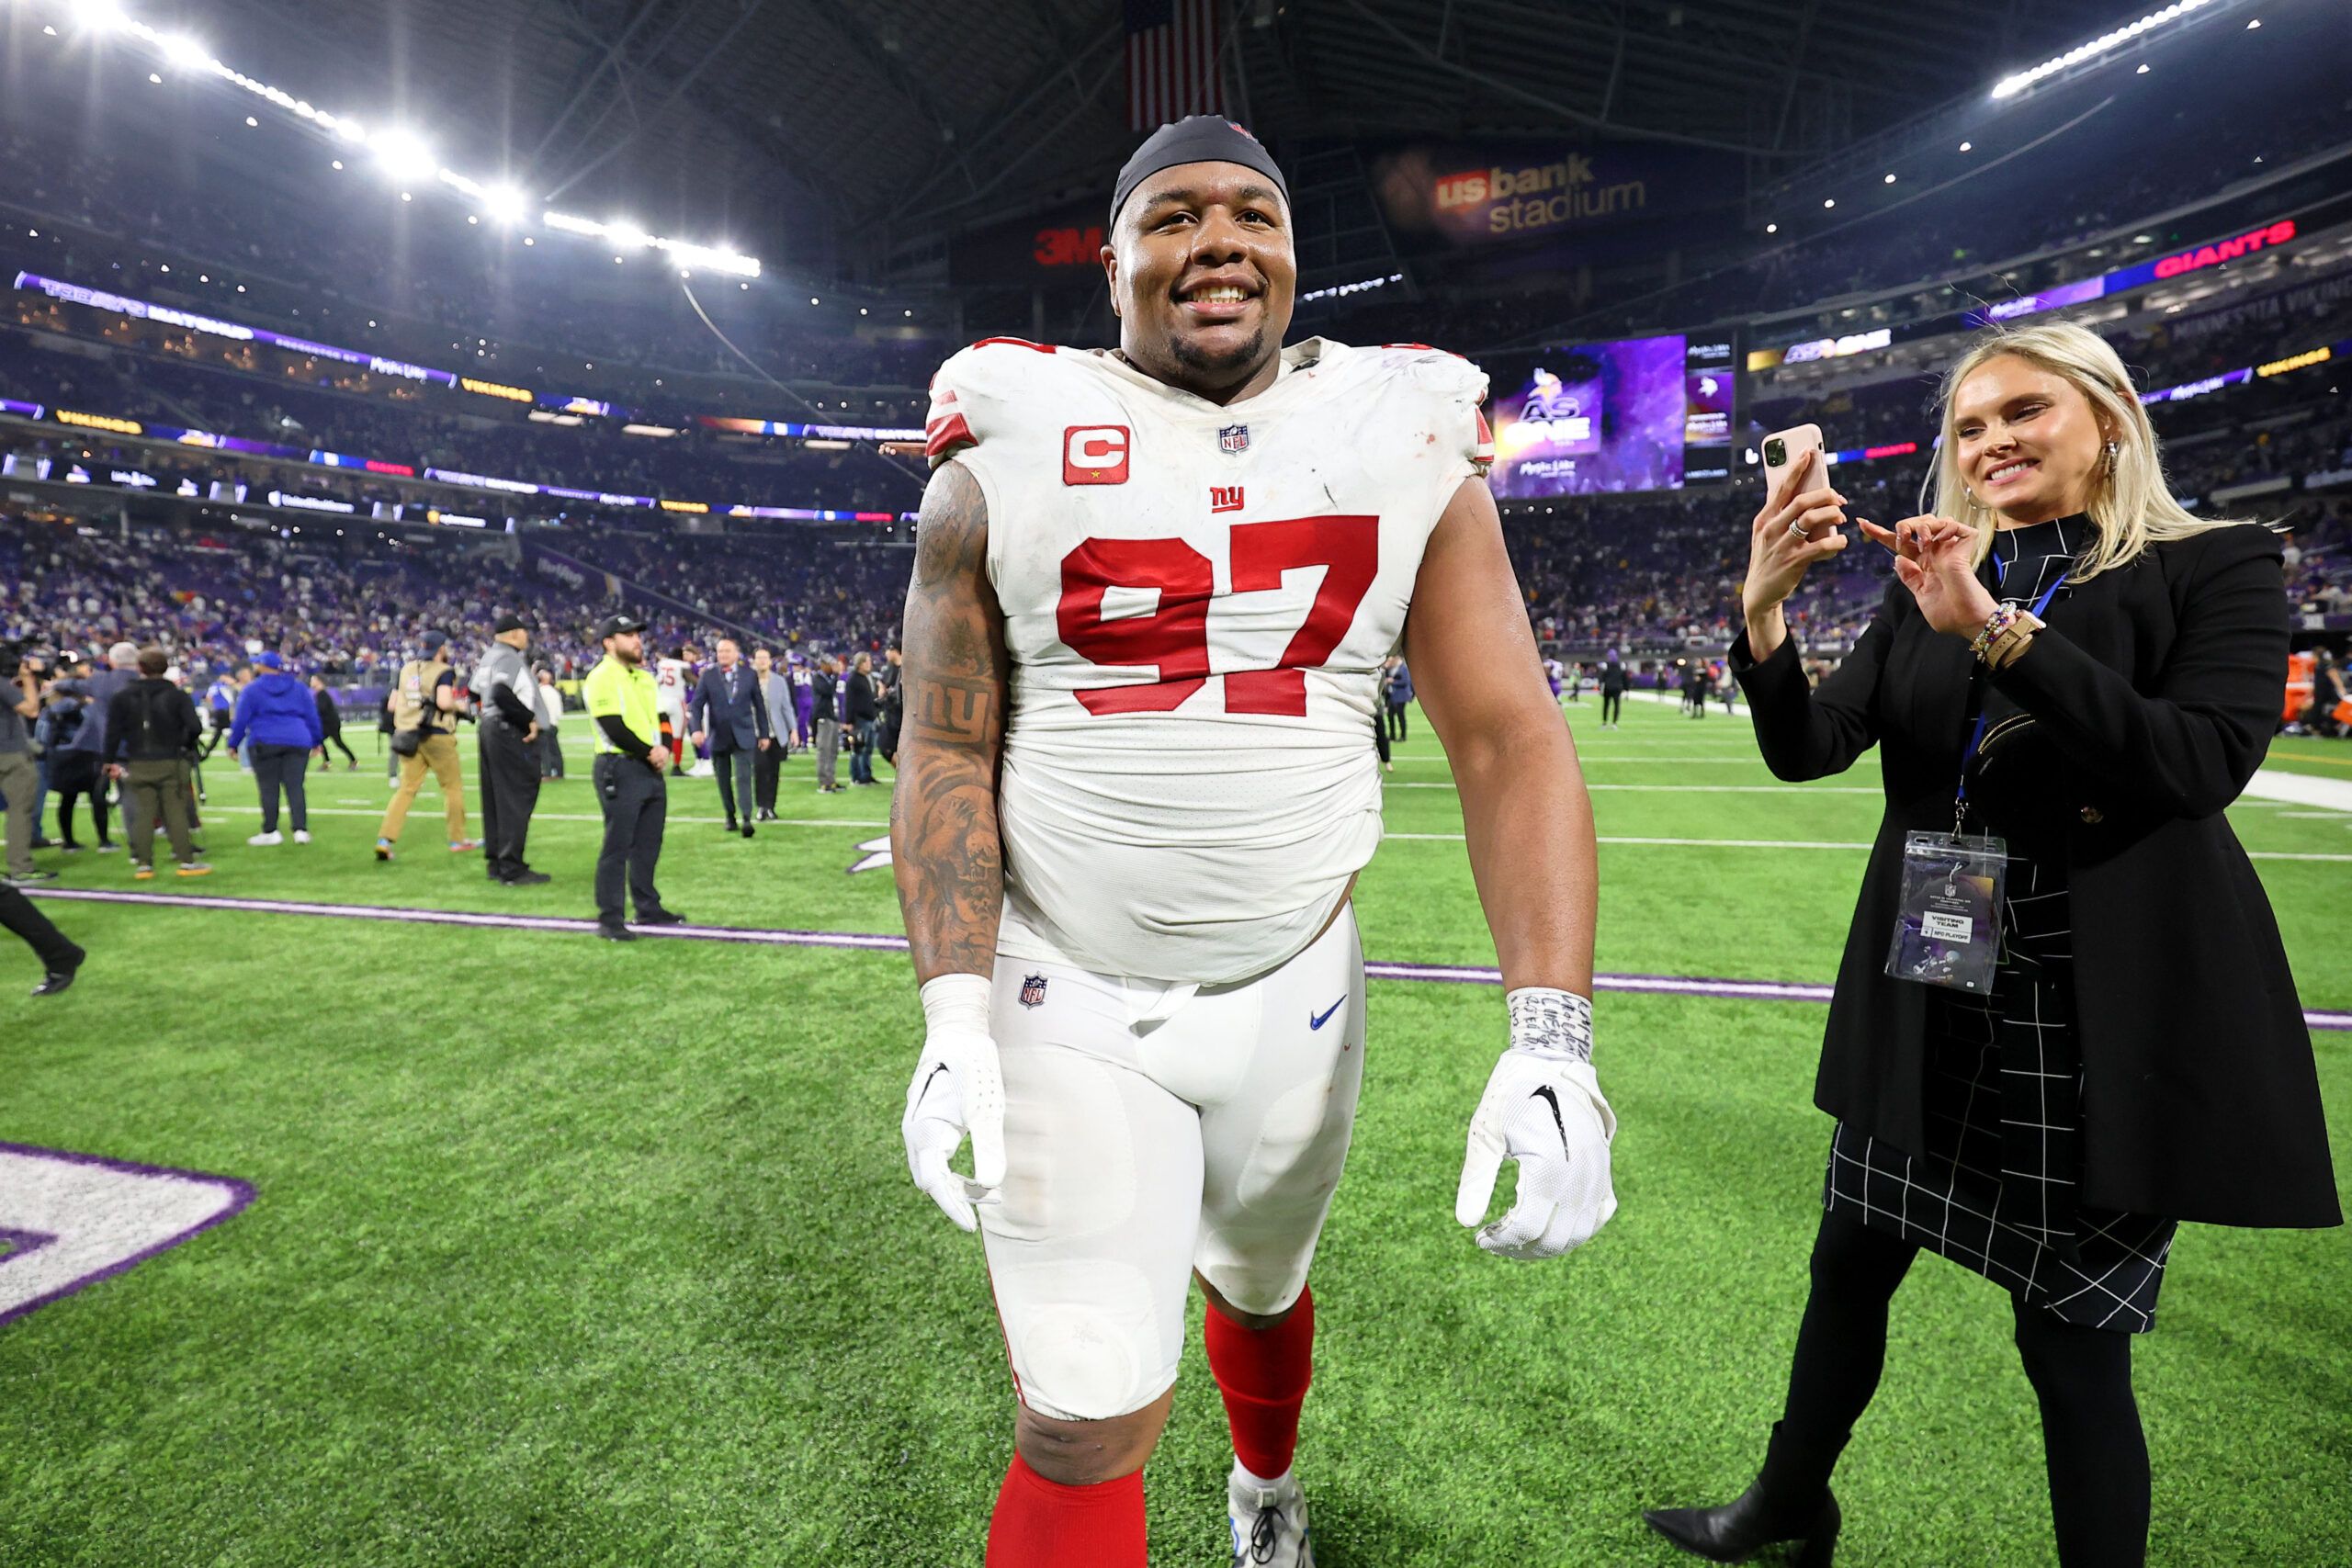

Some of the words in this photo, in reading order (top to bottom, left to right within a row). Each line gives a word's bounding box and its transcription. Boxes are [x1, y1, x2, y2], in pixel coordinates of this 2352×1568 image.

[1489, 181, 1645, 232] stadium
[1035, 227, 1102, 265] 3M
[2154, 220, 2296, 278] GIANTS
[2256, 346, 2331, 378] VIKINGS
[461, 377, 533, 403] VIKINGS
[56, 409, 142, 434] VIKINGS
[1519, 397, 1580, 422] AS
[1504, 416, 1590, 445] ONE
[1069, 428, 1125, 468] C
[1057, 514, 1380, 716] 97
[1932, 915, 1964, 925] VISITING
